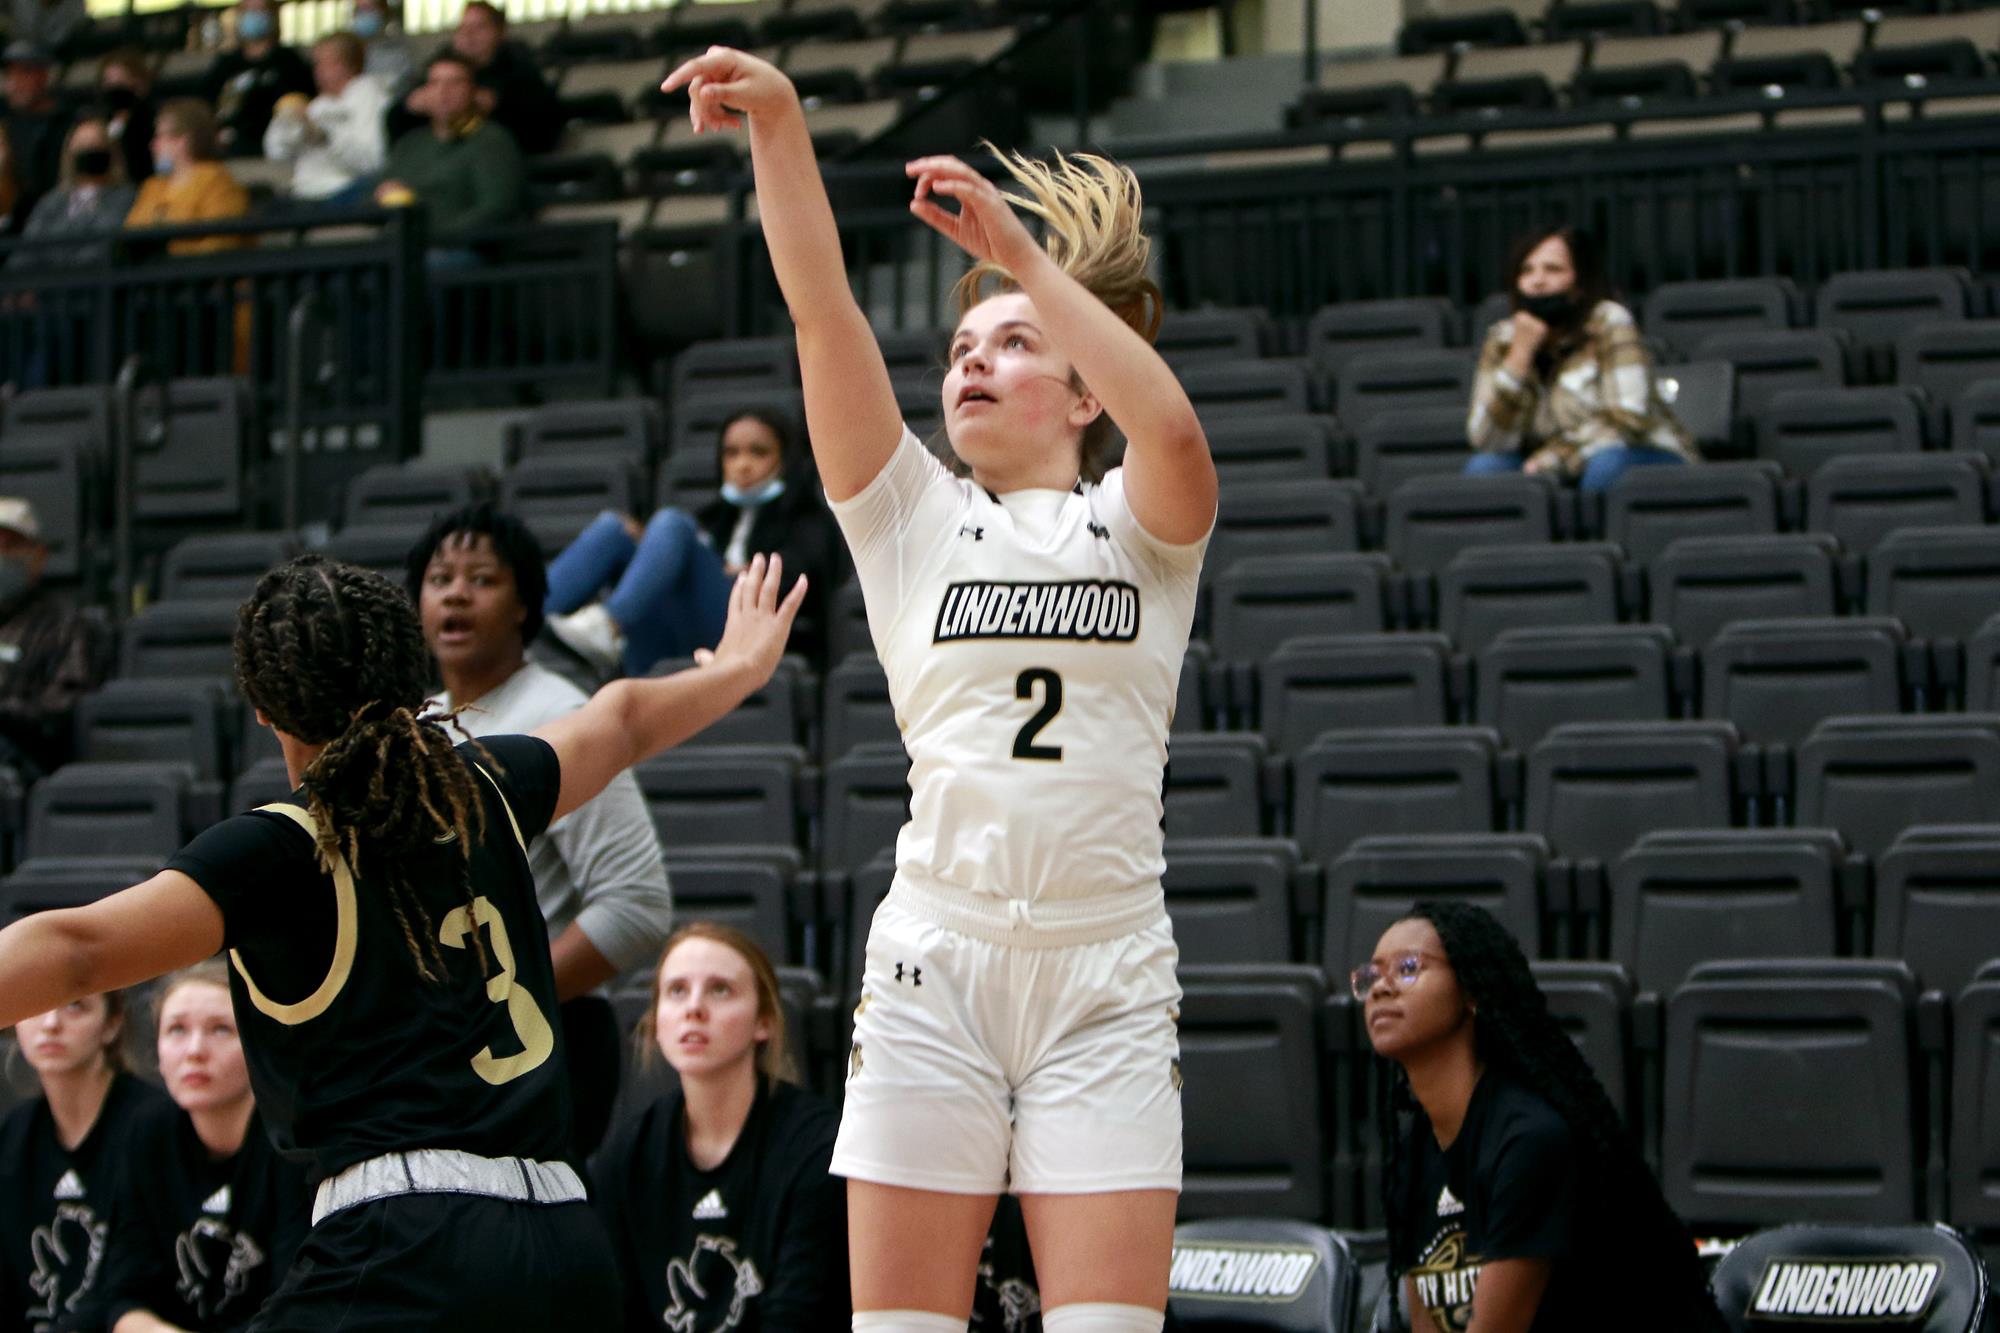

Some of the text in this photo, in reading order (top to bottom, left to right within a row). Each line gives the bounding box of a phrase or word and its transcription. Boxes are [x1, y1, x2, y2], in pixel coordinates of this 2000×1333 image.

[938, 582, 1138, 639] LINDENWOOD
[1011, 667, 1063, 761] 2
[439, 896, 554, 1086] 3
[1169, 1248, 1315, 1296] INDENWOOD
[1754, 1262, 1938, 1316] LINDENWOOD
